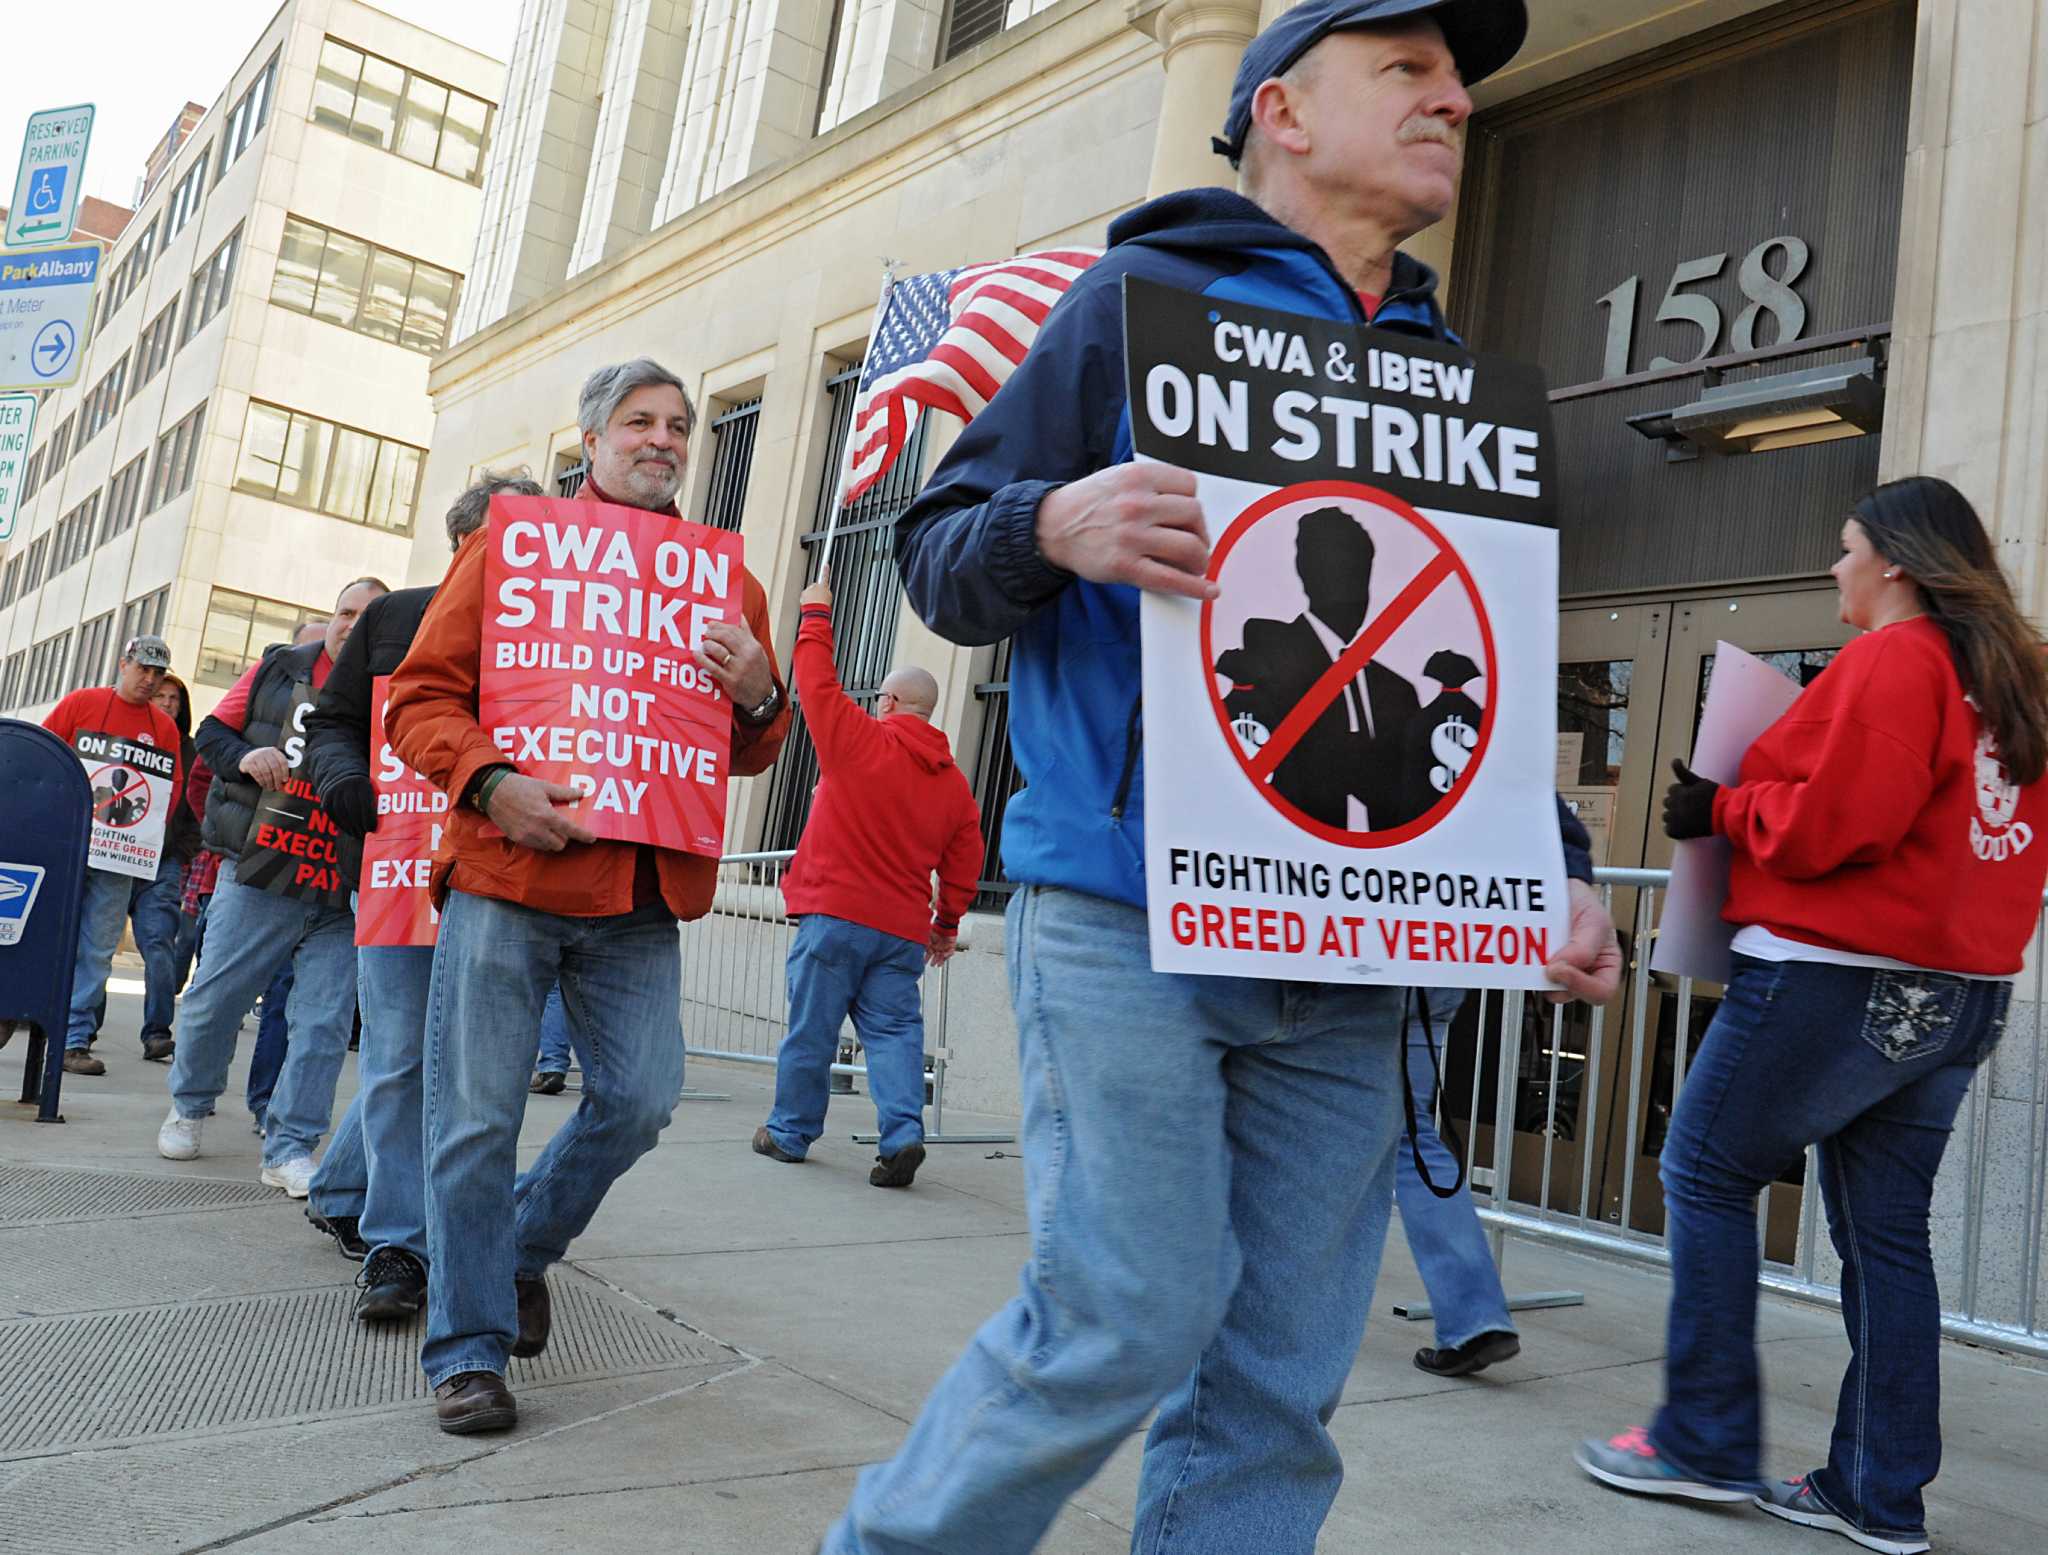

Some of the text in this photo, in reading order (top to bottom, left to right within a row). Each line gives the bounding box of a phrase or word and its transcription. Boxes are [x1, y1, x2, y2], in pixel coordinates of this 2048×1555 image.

[30, 116, 89, 140] RESERVED
[29, 140, 80, 163] PARKING
[3, 260, 94, 280] ParkAlbany
[7, 298, 45, 314] Meter
[1596, 236, 1808, 382] 158
[1213, 319, 1475, 405] CWA & IBEW
[0, 407, 22, 425] TER
[1145, 362, 1541, 499] ON STRIKE
[0, 433, 24, 451] ING
[502, 520, 729, 599] CWA ON
[495, 577, 725, 651] STRIKE
[495, 642, 593, 671] BUILD
[602, 649, 645, 677] UP
[570, 683, 656, 727] NOT
[78, 736, 174, 774] ON STRIKE
[493, 726, 717, 786] EXECUTIVE
[285, 777, 321, 803] UIL
[377, 792, 448, 815] BUILD
[568, 774, 649, 815] PAY
[92, 837, 156, 859] RATE GREED
[94, 827, 136, 844] GHTING
[255, 823, 338, 864] EXECU
[89, 848, 154, 868] ZON WIRELESS
[1169, 847, 1545, 912] FIGHTING CORPORATE
[1170, 902, 1549, 966] GREED AT VERIZON
